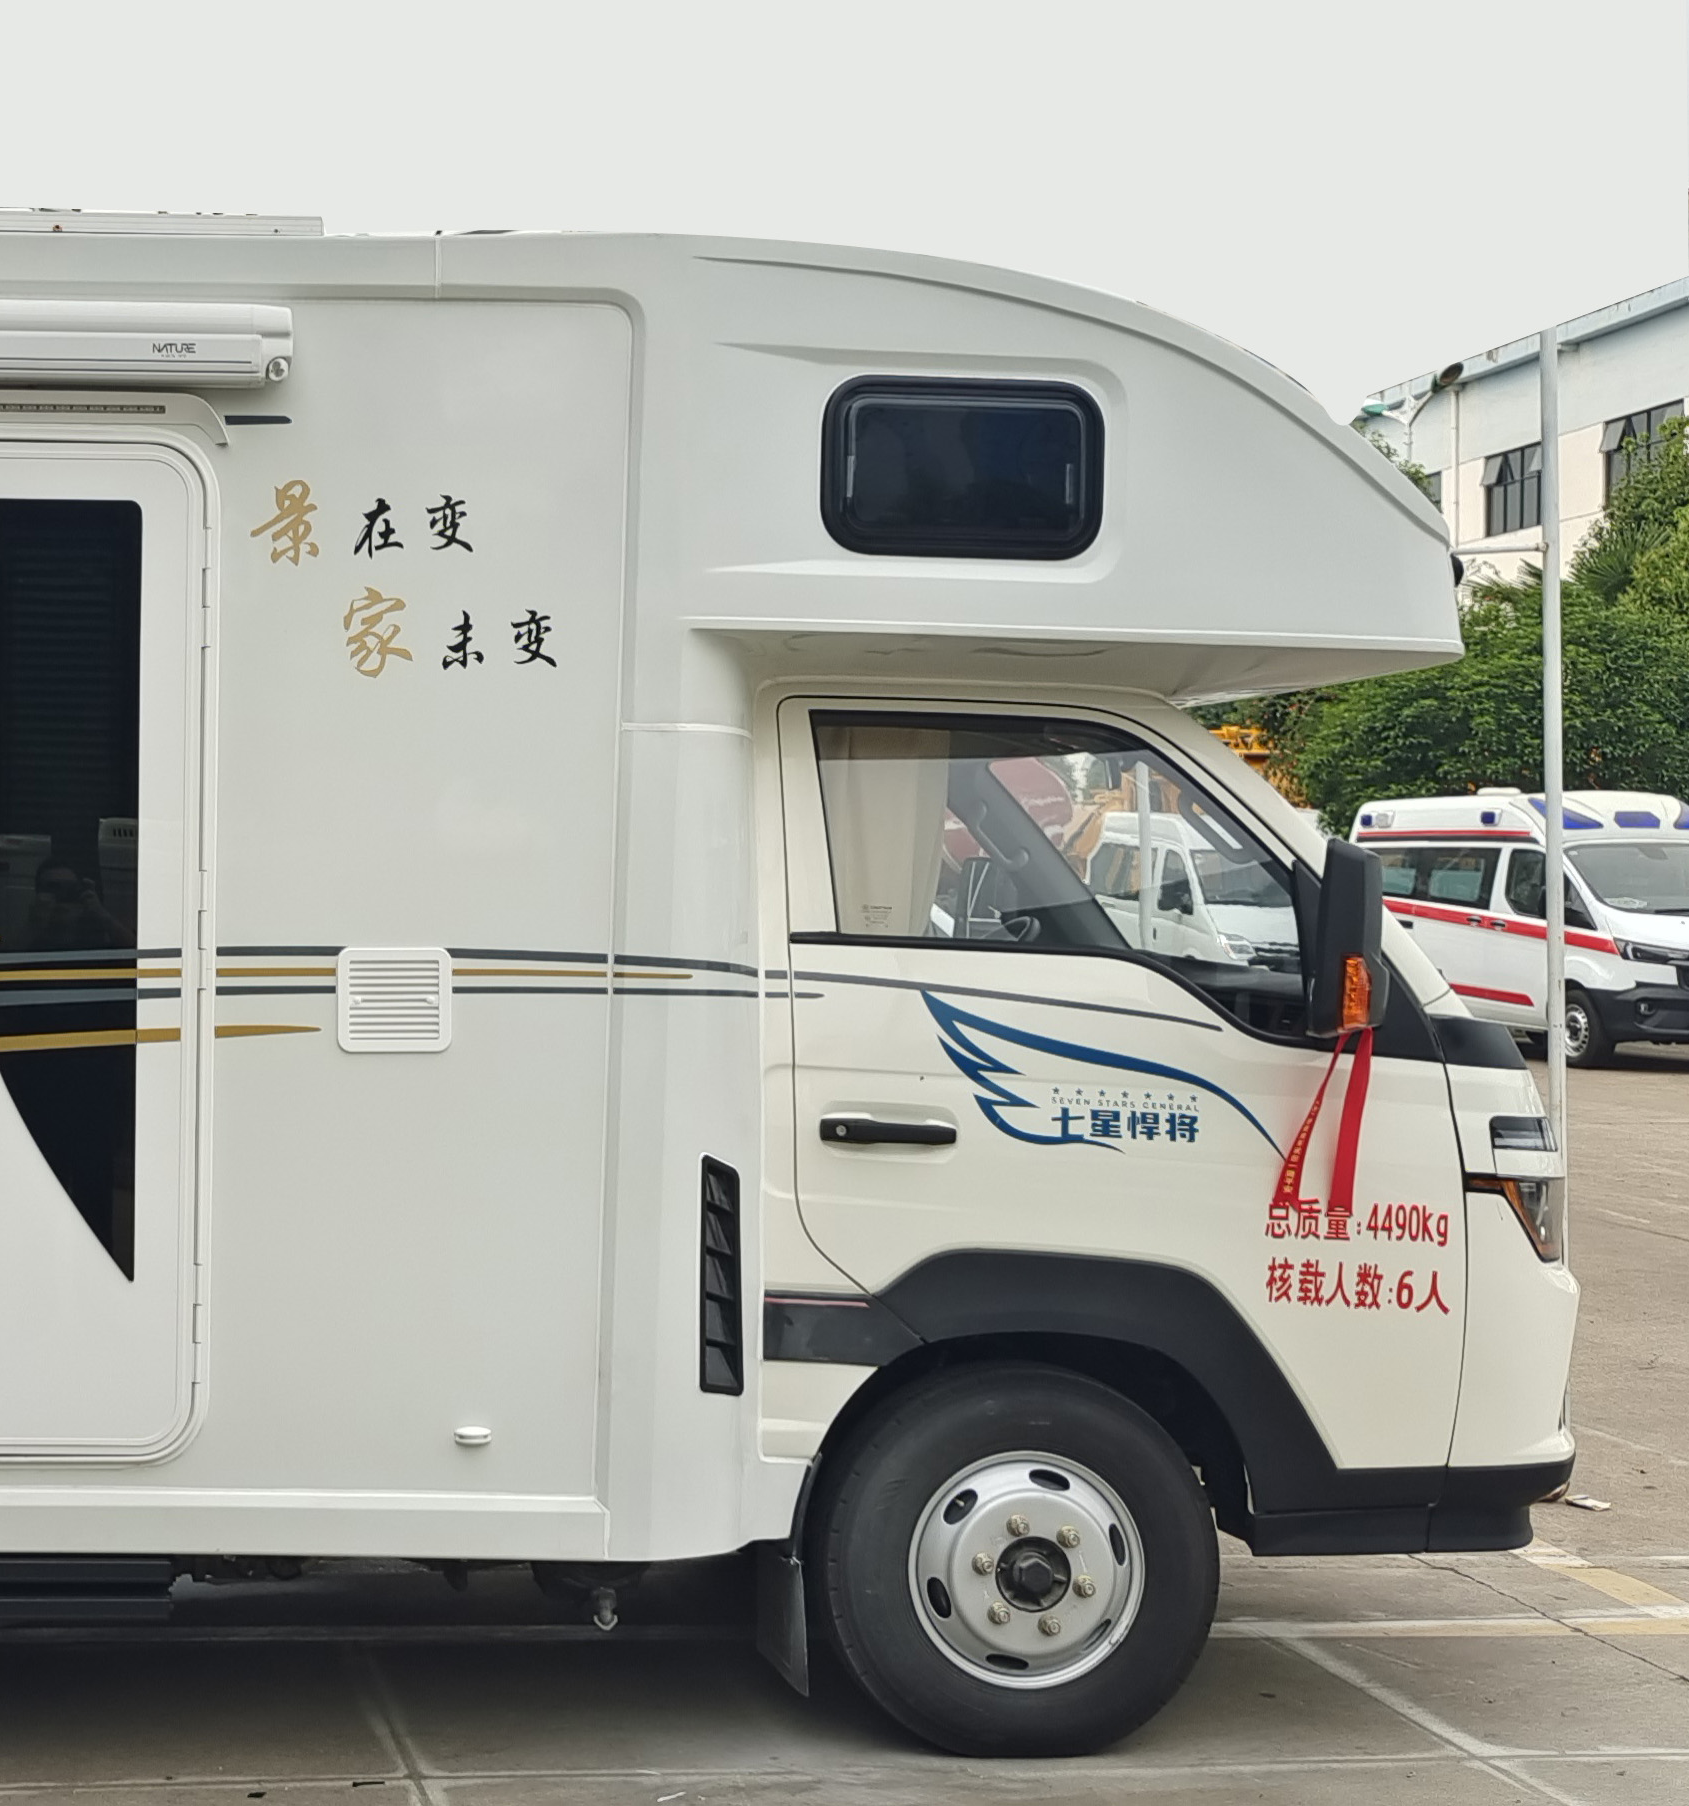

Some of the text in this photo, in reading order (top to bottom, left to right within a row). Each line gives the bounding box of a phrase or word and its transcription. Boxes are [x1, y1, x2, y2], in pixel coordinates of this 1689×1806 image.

[152, 342, 197, 354] NATURE
[1051, 1096, 1091, 1106] SEVEN
[1097, 1099, 1137, 1109] STARS
[1051, 1106, 1200, 1143] 七星悍将
